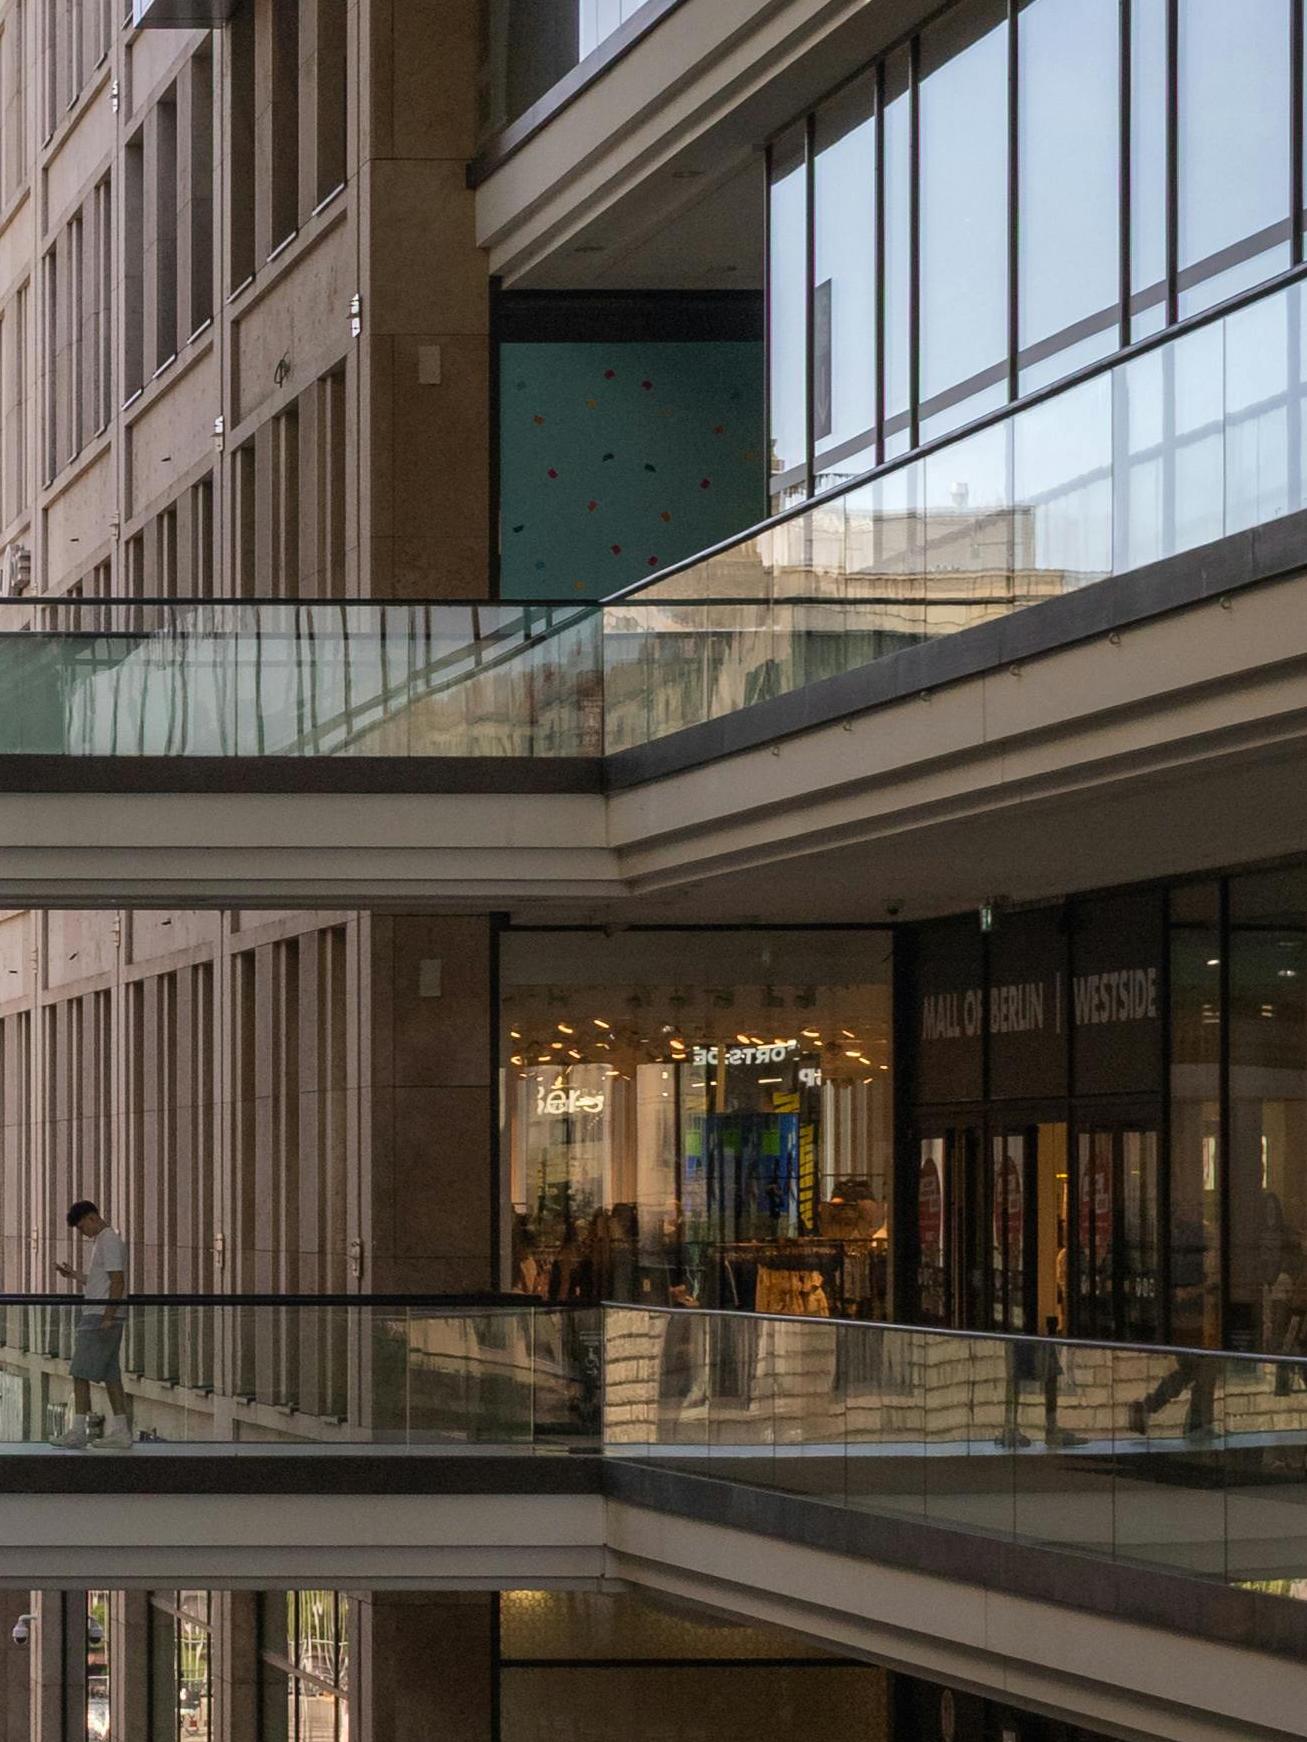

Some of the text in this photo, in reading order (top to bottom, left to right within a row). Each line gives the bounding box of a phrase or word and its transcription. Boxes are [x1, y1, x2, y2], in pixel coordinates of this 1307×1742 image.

[922, 993, 960, 1040] MALL
[990, 983, 1043, 1033] BERLIN
[1072, 967, 1158, 1025] WESTSIDE
